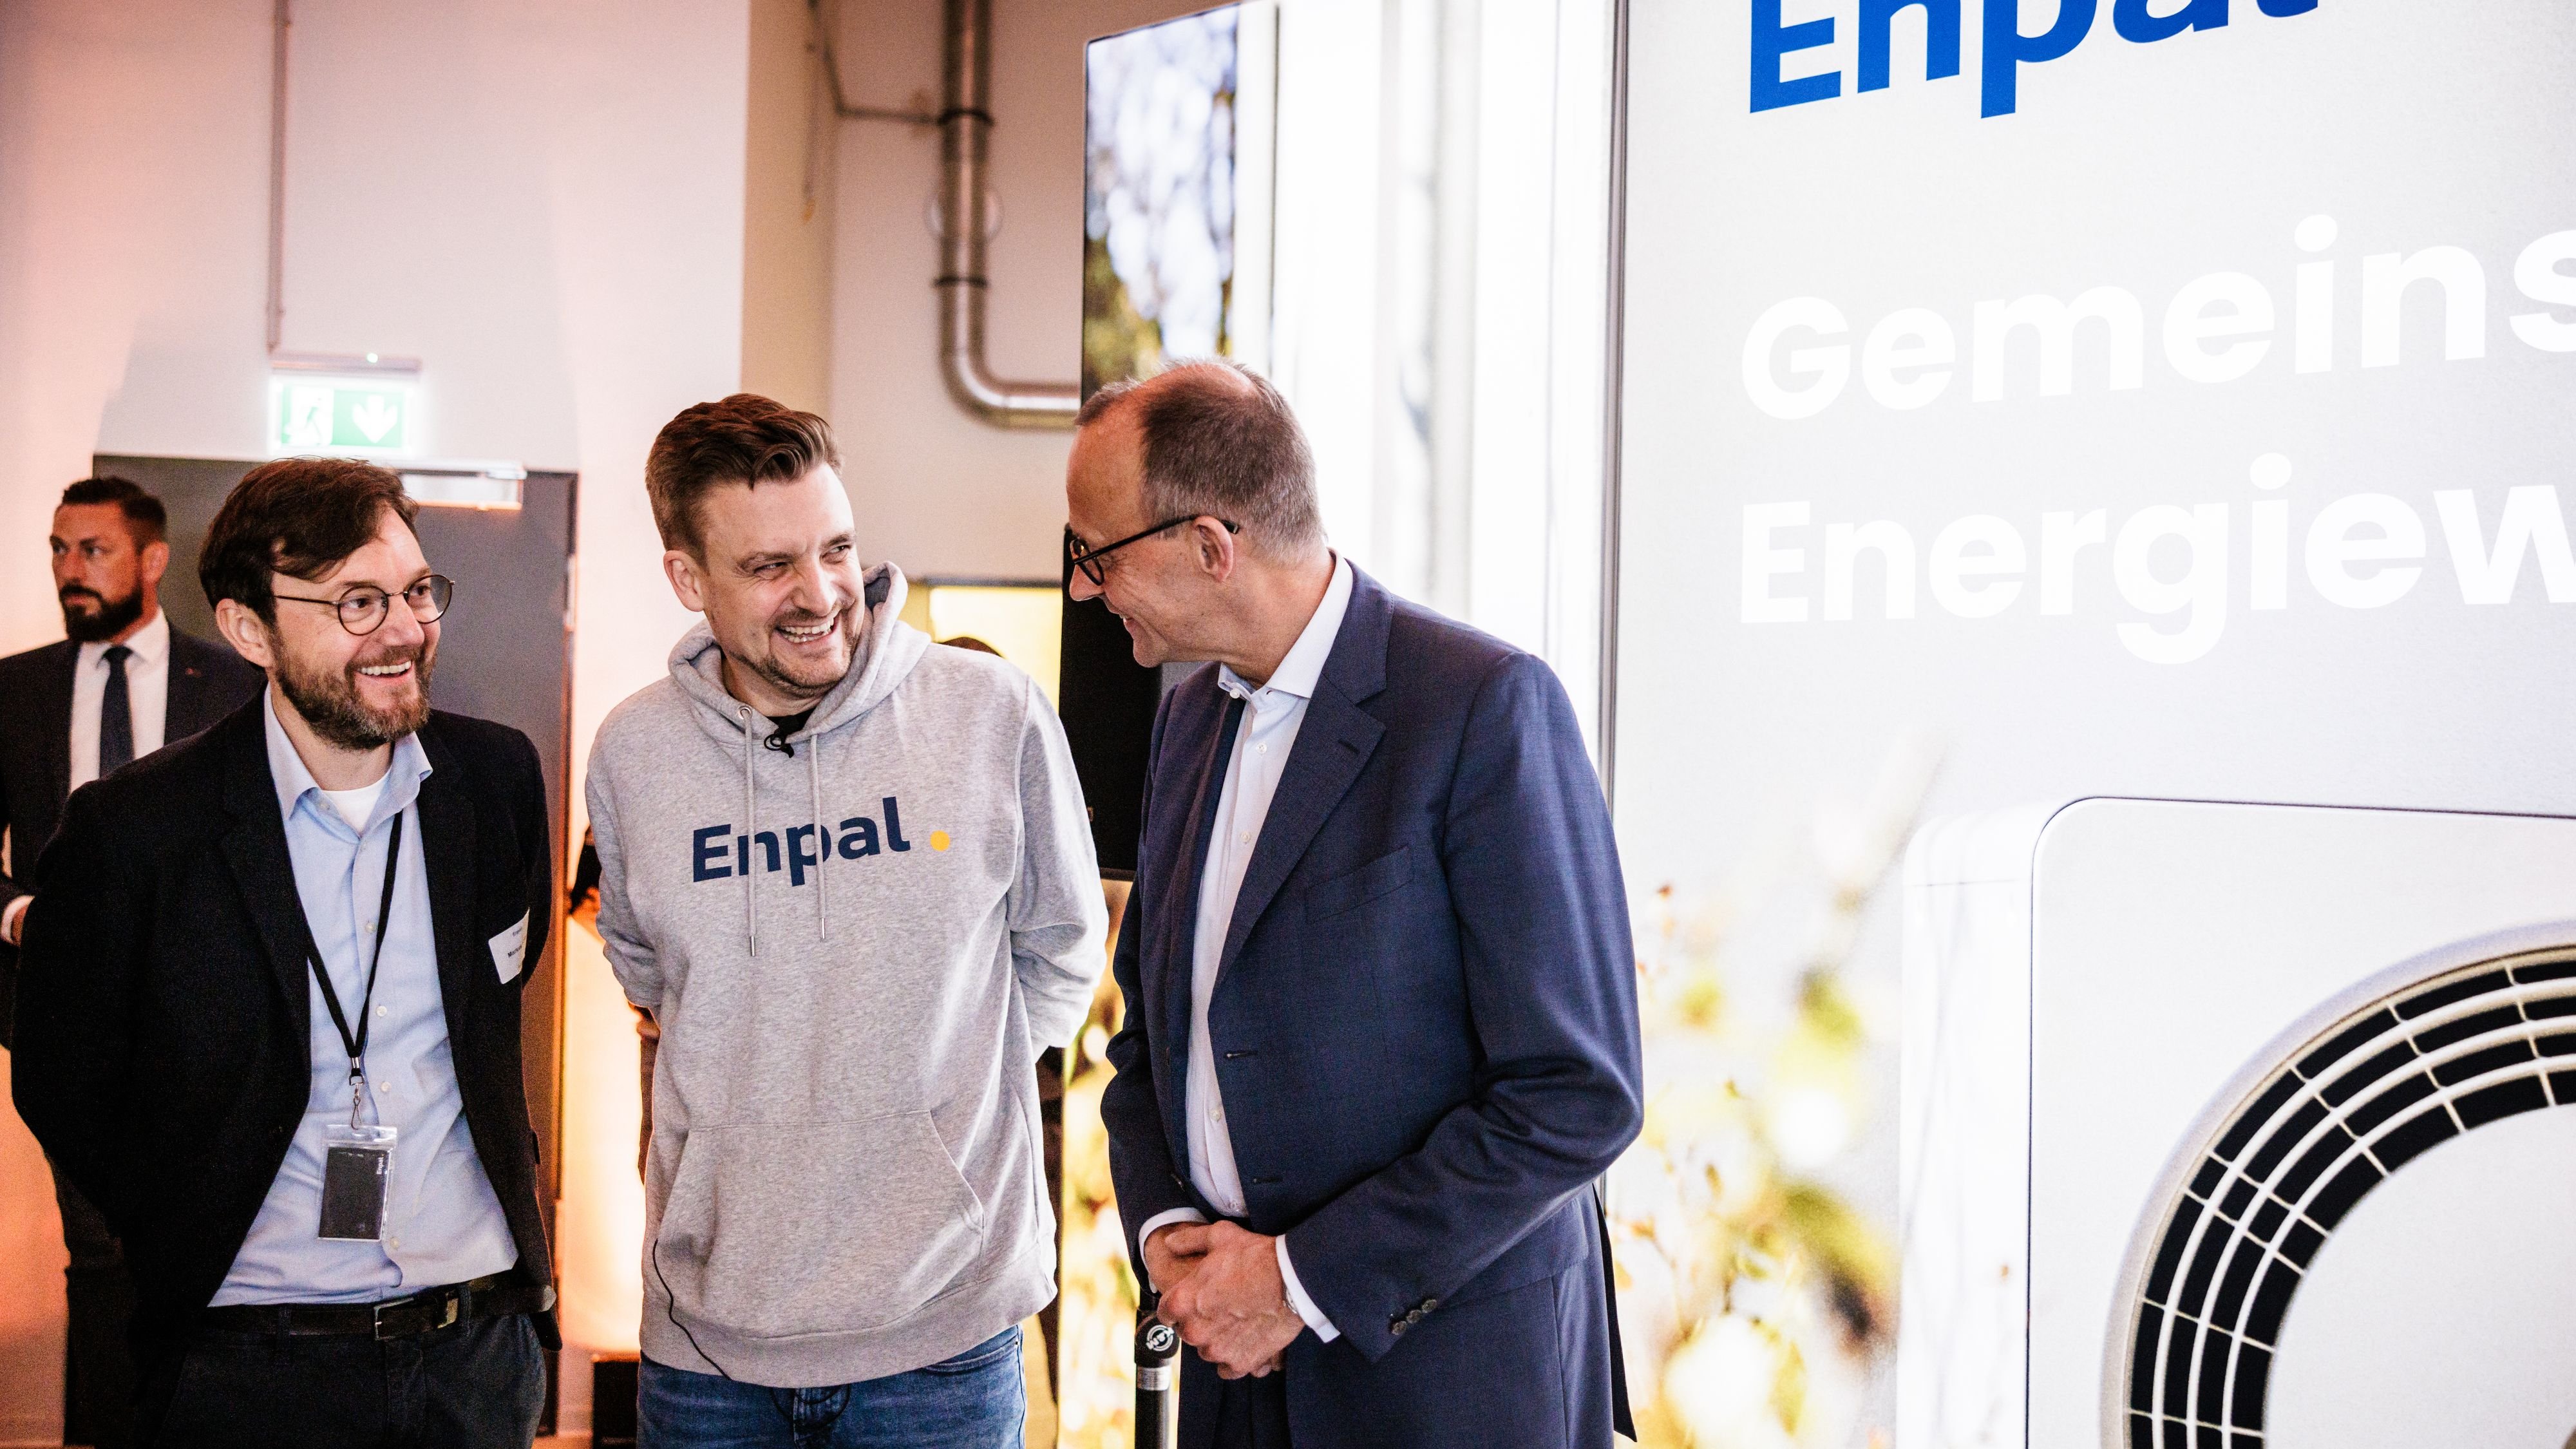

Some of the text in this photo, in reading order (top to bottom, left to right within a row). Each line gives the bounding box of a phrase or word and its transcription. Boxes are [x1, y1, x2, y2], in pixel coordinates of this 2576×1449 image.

[1750, 0, 2319, 119] Enp
[1741, 214, 2576, 420] Gemeins
[1740, 452, 2576, 665] Energiew
